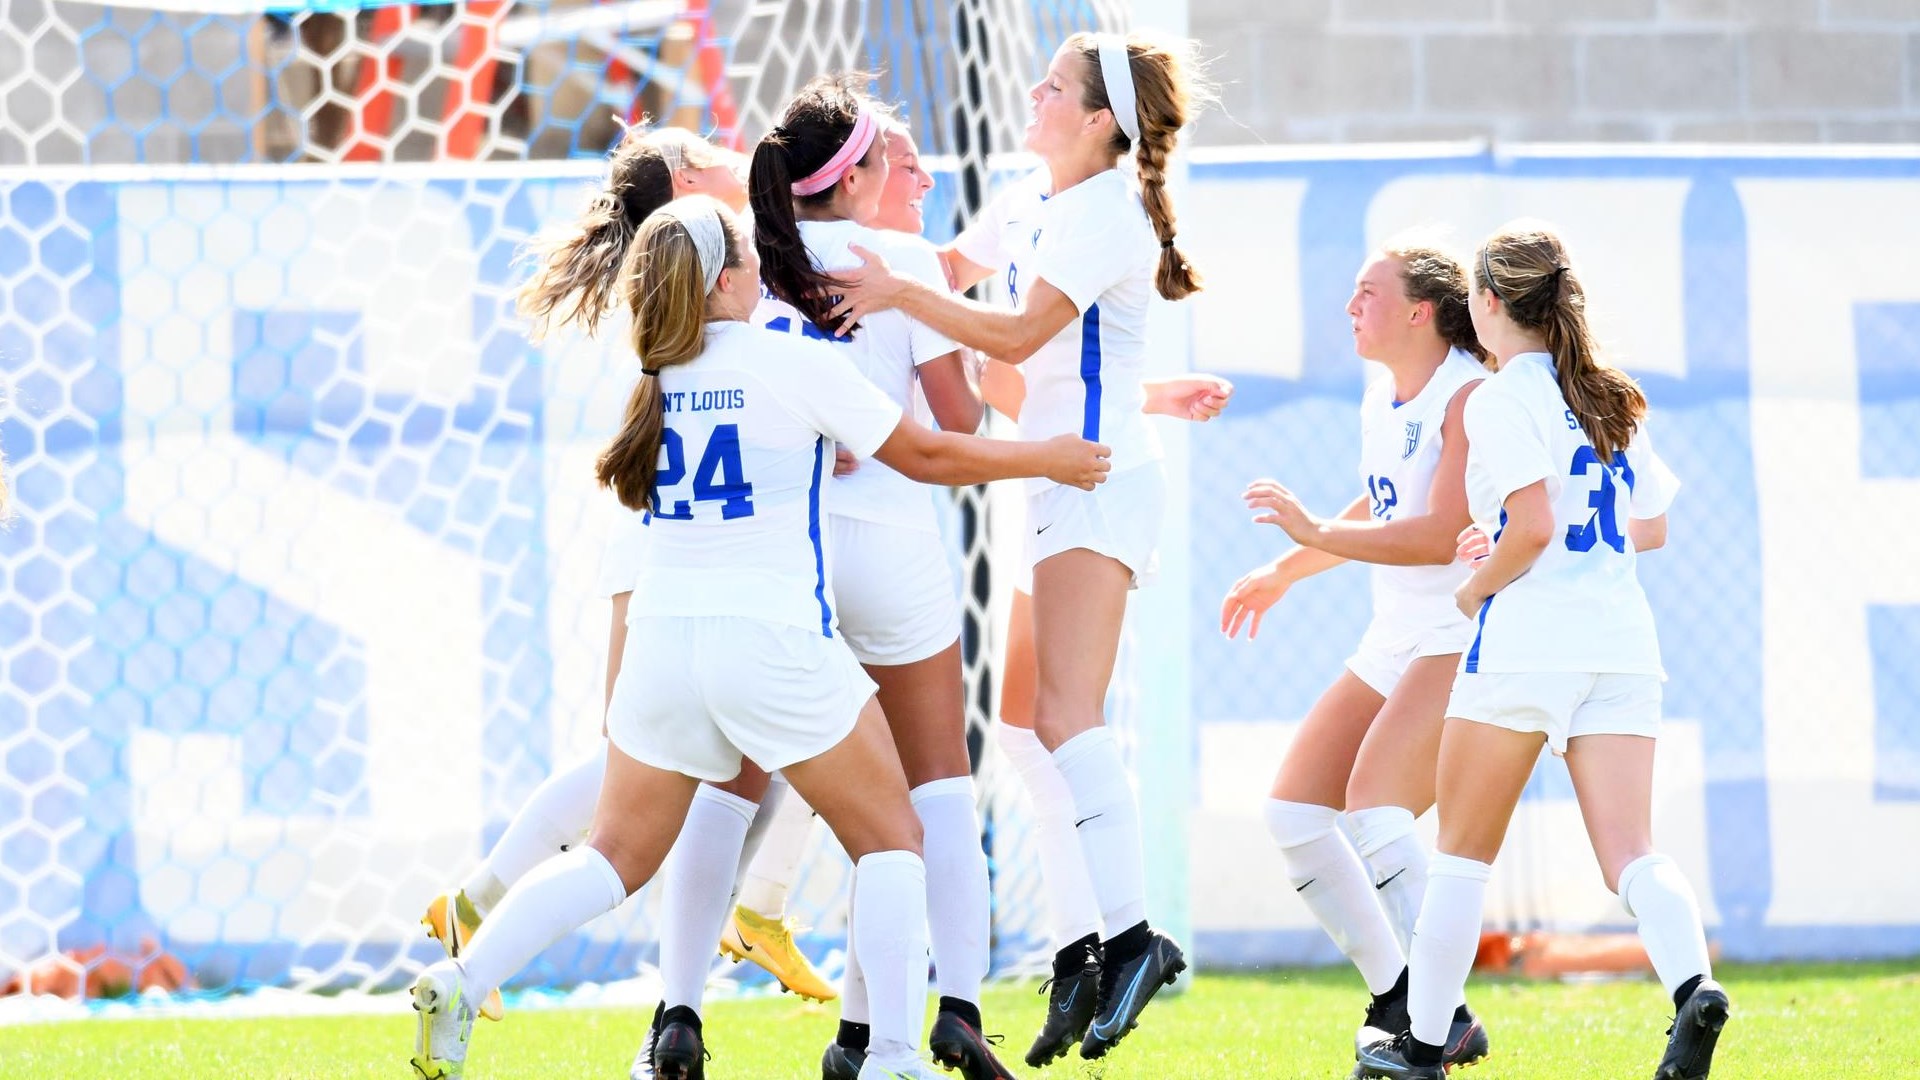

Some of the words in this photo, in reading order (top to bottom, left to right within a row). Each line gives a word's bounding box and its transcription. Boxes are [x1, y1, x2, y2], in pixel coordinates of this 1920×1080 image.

[690, 389, 745, 411] LOUIS
[653, 423, 755, 520] 24
[1564, 444, 1636, 554] 30
